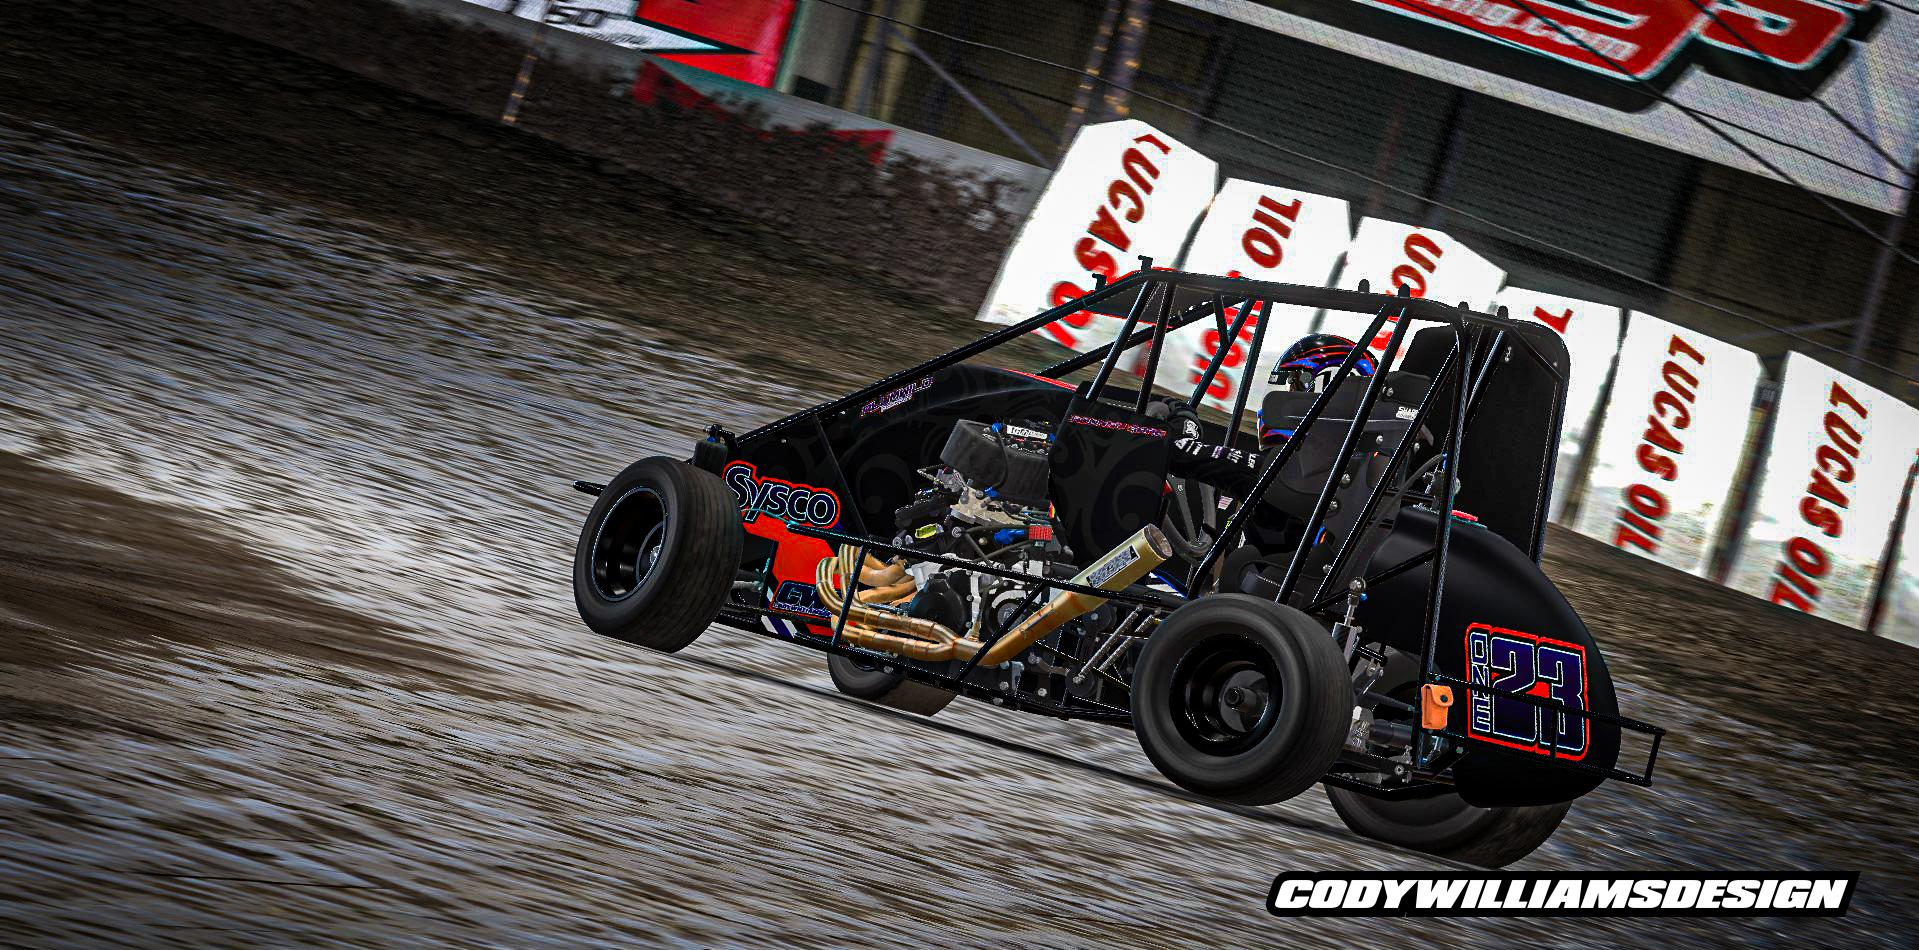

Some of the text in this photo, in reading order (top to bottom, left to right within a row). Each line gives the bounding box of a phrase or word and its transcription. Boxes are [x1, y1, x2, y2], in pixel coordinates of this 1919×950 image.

[1073, 133, 1172, 285] LUCAS
[1241, 194, 1303, 269] OIL
[1612, 333, 1706, 555] LUCAS OIL
[1769, 381, 1869, 614] LUCAS OIL
[1490, 635, 1585, 752] 23
